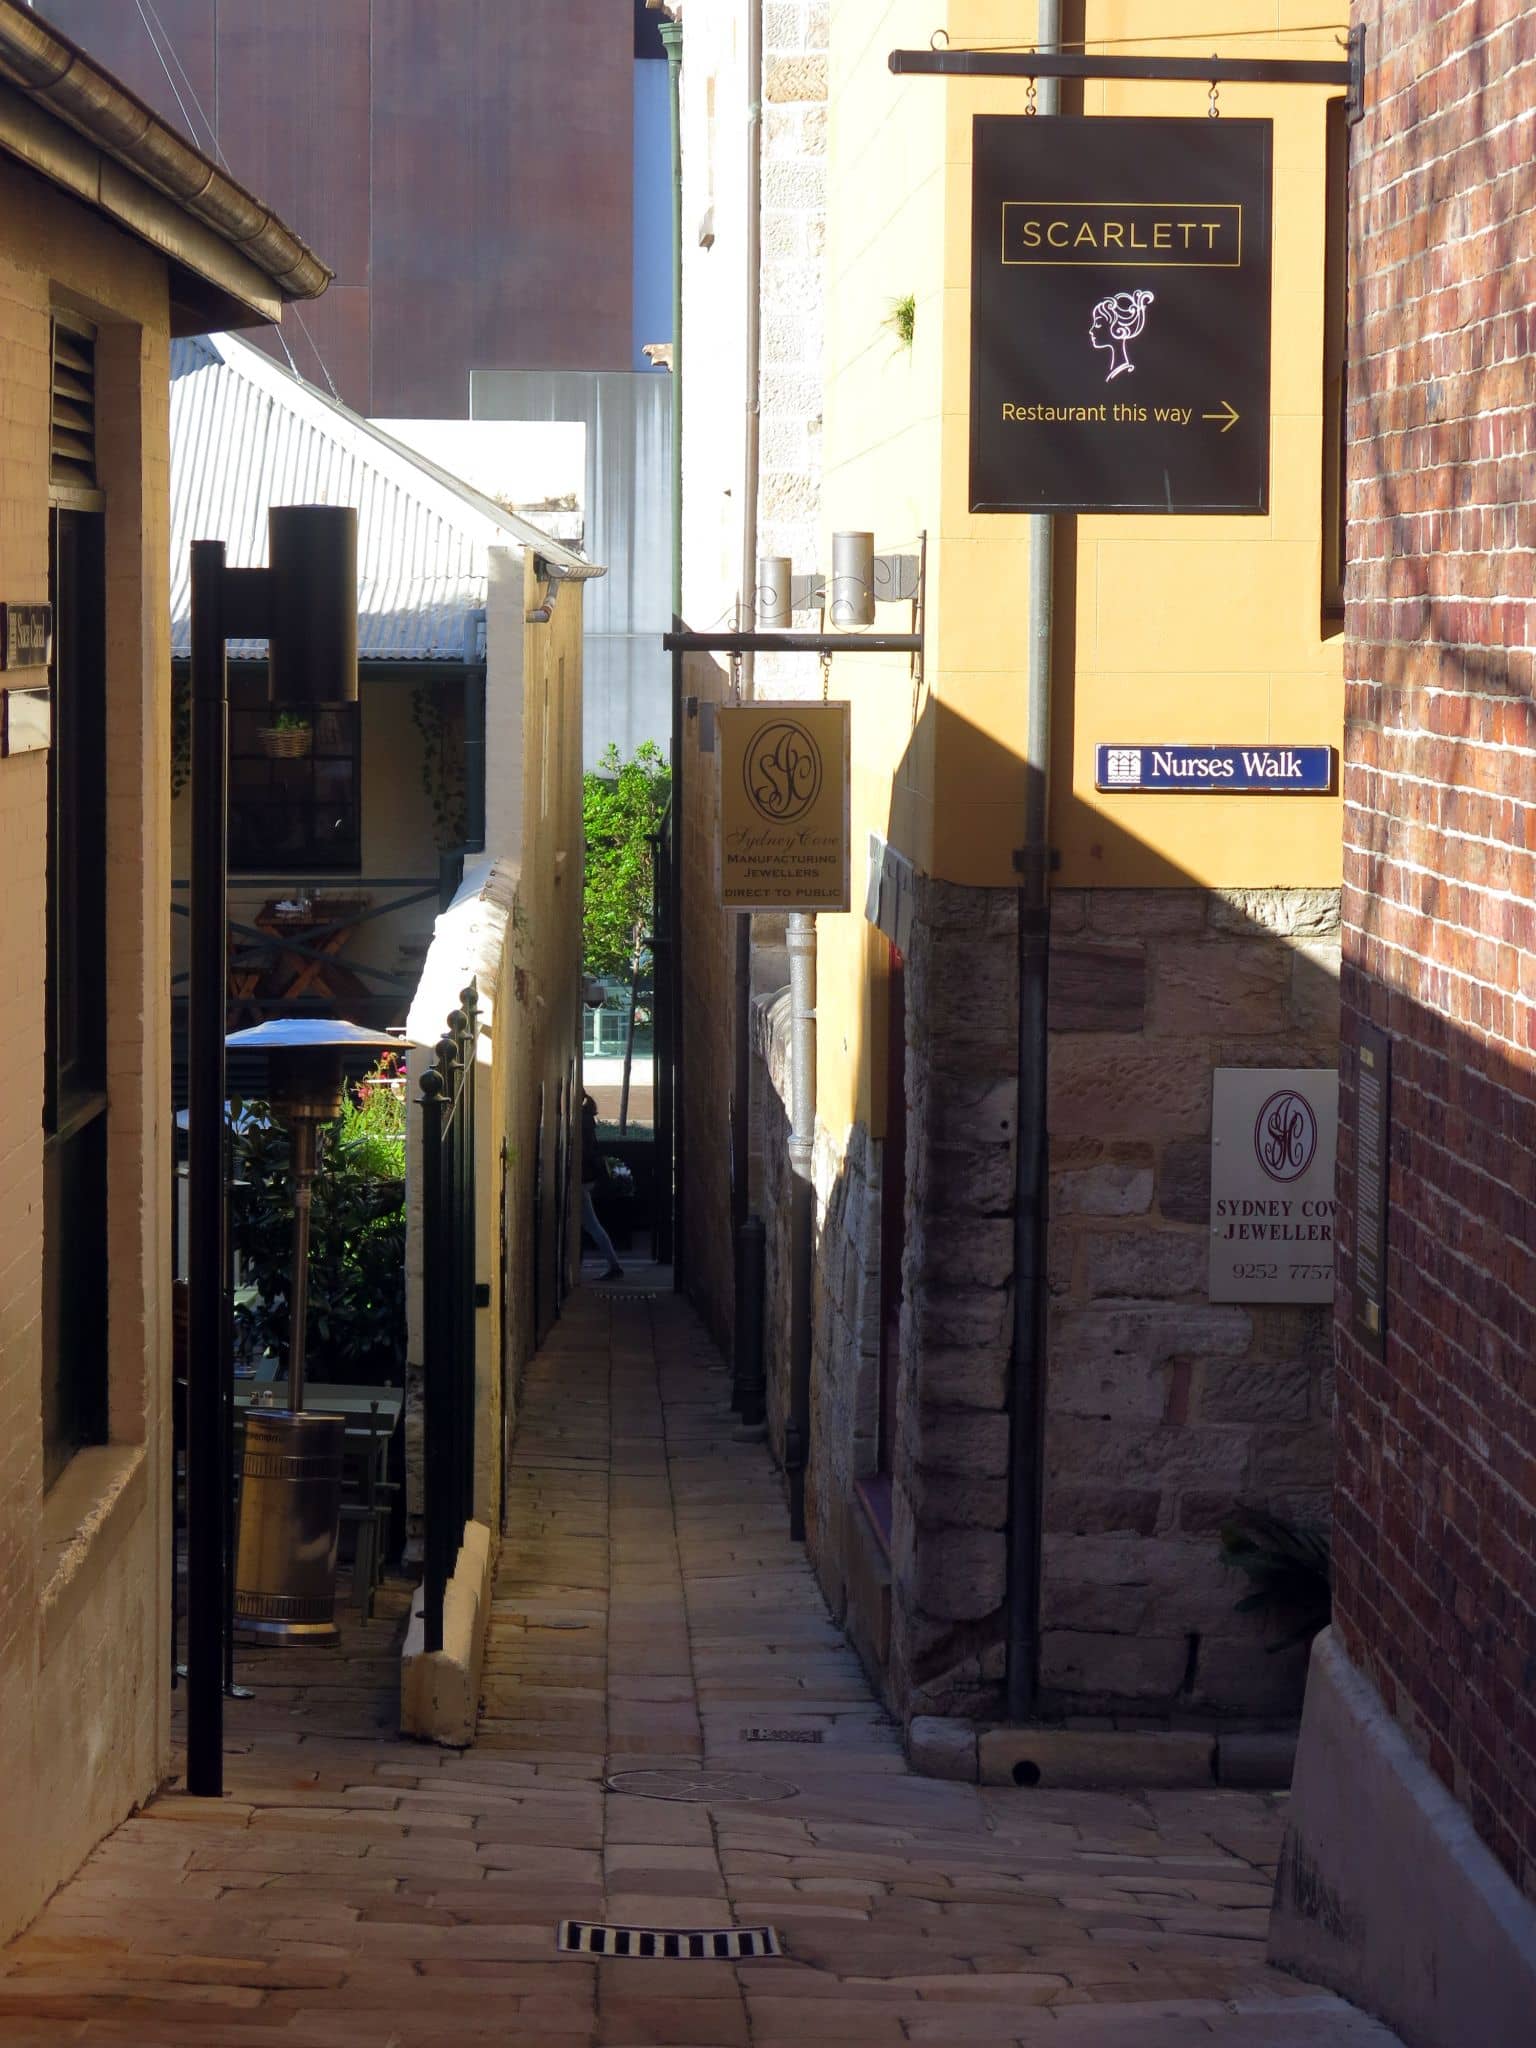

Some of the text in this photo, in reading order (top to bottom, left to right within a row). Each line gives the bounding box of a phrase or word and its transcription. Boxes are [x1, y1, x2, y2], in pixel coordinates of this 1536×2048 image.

[1022, 220, 1222, 249] SCARLETT
[1002, 402, 1193, 425] Restaurant this way
[1151, 751, 1303, 777] Nurses Walk
[727, 854, 837, 865] MANUFACTURING
[744, 867, 820, 878] JEWELLERS
[724, 888, 841, 897] DIRECT TO PUBLIC
[1216, 1199, 1337, 1217] SYDNEY COV
[1223, 1223, 1332, 1241] JEWELLER
[1232, 1263, 1335, 1280] 9252 7757
